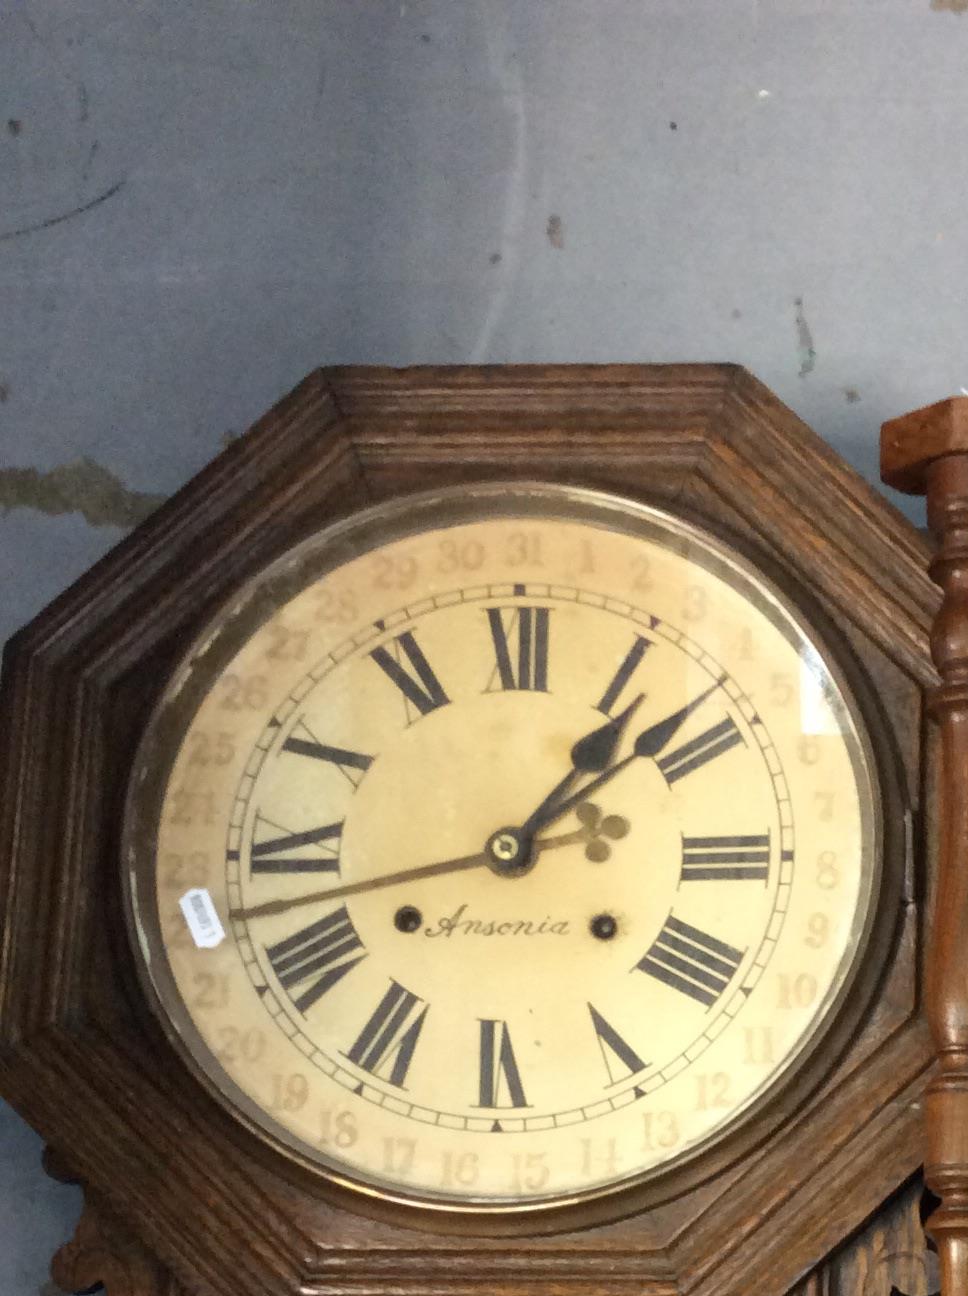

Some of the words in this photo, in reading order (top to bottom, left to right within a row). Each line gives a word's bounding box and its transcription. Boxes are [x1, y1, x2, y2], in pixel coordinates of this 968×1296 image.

[437, 540, 485, 574] 30
[507, 531, 544, 566] 31
[374, 555, 417, 589] 29
[481, 605, 556, 694] XII
[361, 627, 452, 729] XI
[591, 632, 657, 718] I
[277, 714, 380, 794] X
[652, 711, 749, 791] II
[249, 808, 347, 881] IX
[676, 826, 772, 892] III
[424, 904, 570, 938] Ansonia
[265, 902, 370, 1021] VIII
[195, 972, 230, 1009] 21
[775, 972, 818, 1010] 10
[217, 1026, 267, 1062] 20
[338, 977, 431, 1092] VII
[587, 1001, 652, 1089] V
[742, 1026, 774, 1065] 11
[469, 1017, 534, 1109] VI
[271, 1073, 310, 1112] 19
[695, 1071, 733, 1110] 12
[317, 1110, 359, 1149] 18
[641, 1111, 680, 1151] 13
[382, 1137, 417, 1173] 17
[440, 1153, 480, 1187] 16
[511, 1152, 551, 1191] 15
